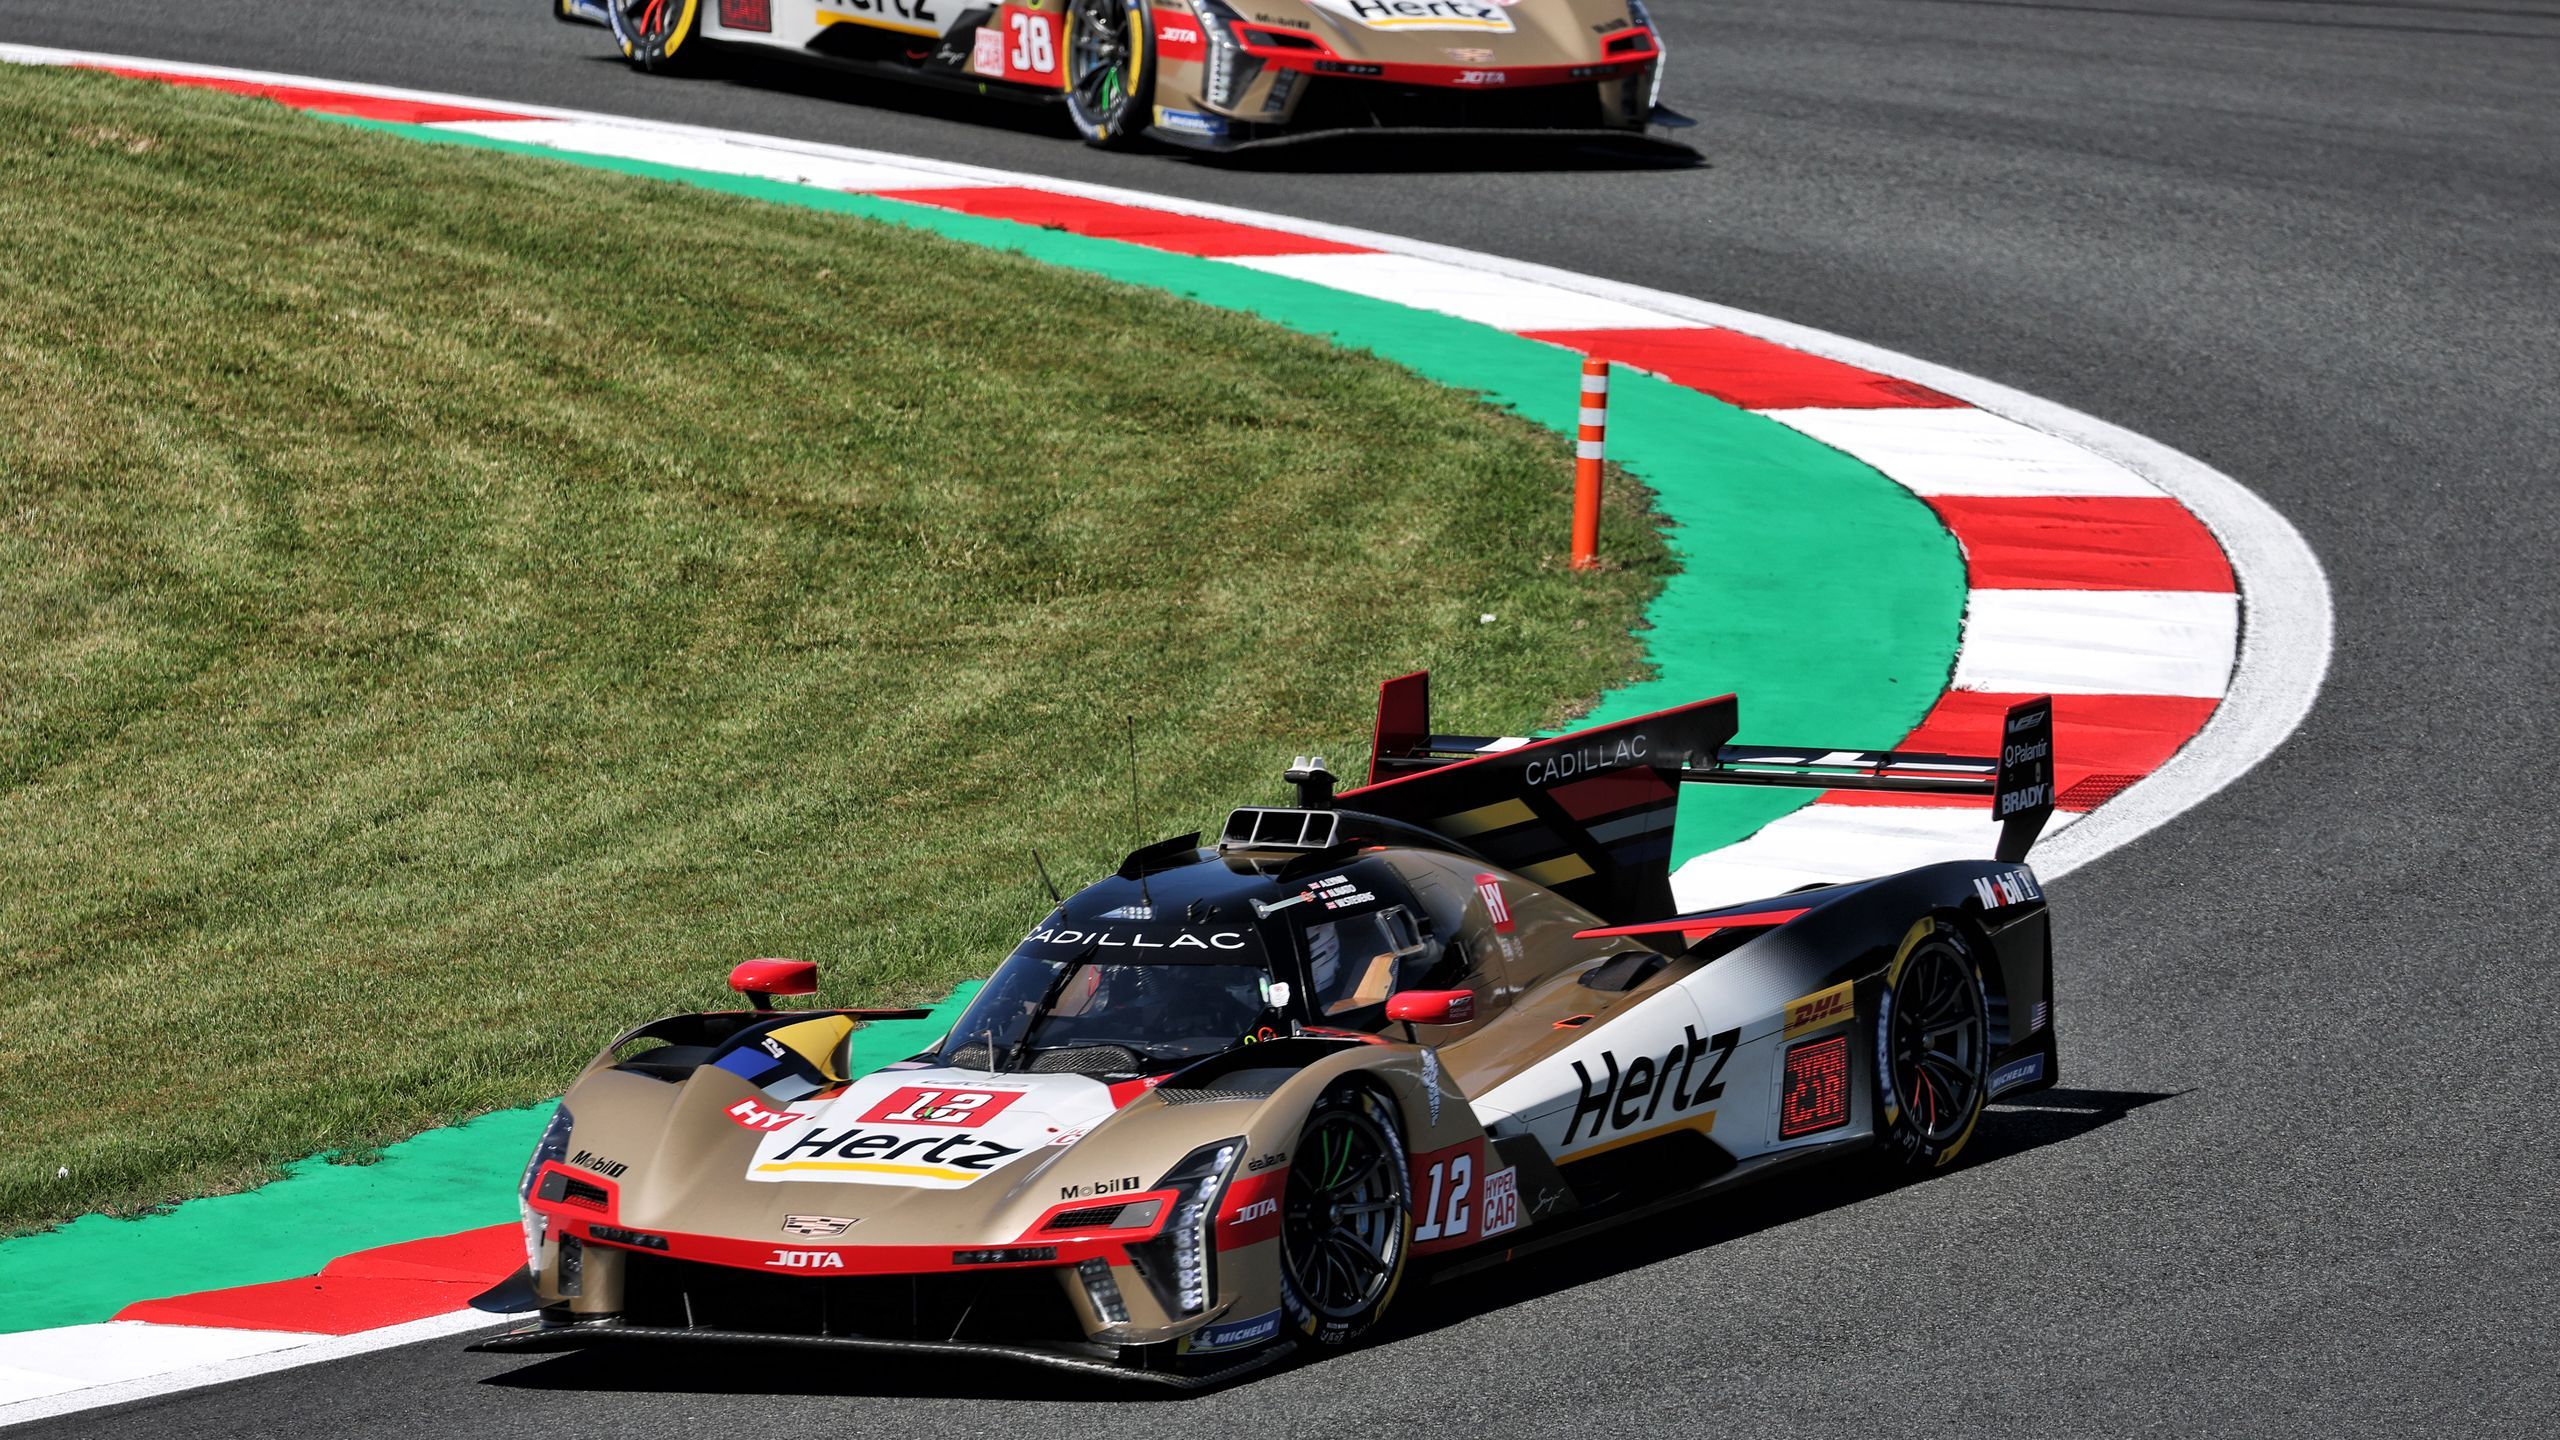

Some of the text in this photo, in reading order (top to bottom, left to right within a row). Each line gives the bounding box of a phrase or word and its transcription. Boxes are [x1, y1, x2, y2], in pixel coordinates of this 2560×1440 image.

[1011, 13, 1055, 73] 38
[1526, 735, 1647, 785] CADILLAC
[2014, 738, 2048, 764] Palantir
[2002, 784, 2045, 815] BRADY
[761, 1037, 787, 1060] 12
[1562, 1025, 1742, 1146] Hertz
[729, 1101, 796, 1128] HY
[882, 1091, 994, 1122] 12
[772, 1128, 1024, 1170] Hertz
[1230, 1198, 1277, 1225] JOTA
[1414, 1154, 1472, 1241] 12
[1485, 1193, 1516, 1231] CAR
[765, 1250, 845, 1268] JOTA
[1214, 1319, 1275, 1344] MICHELIN
